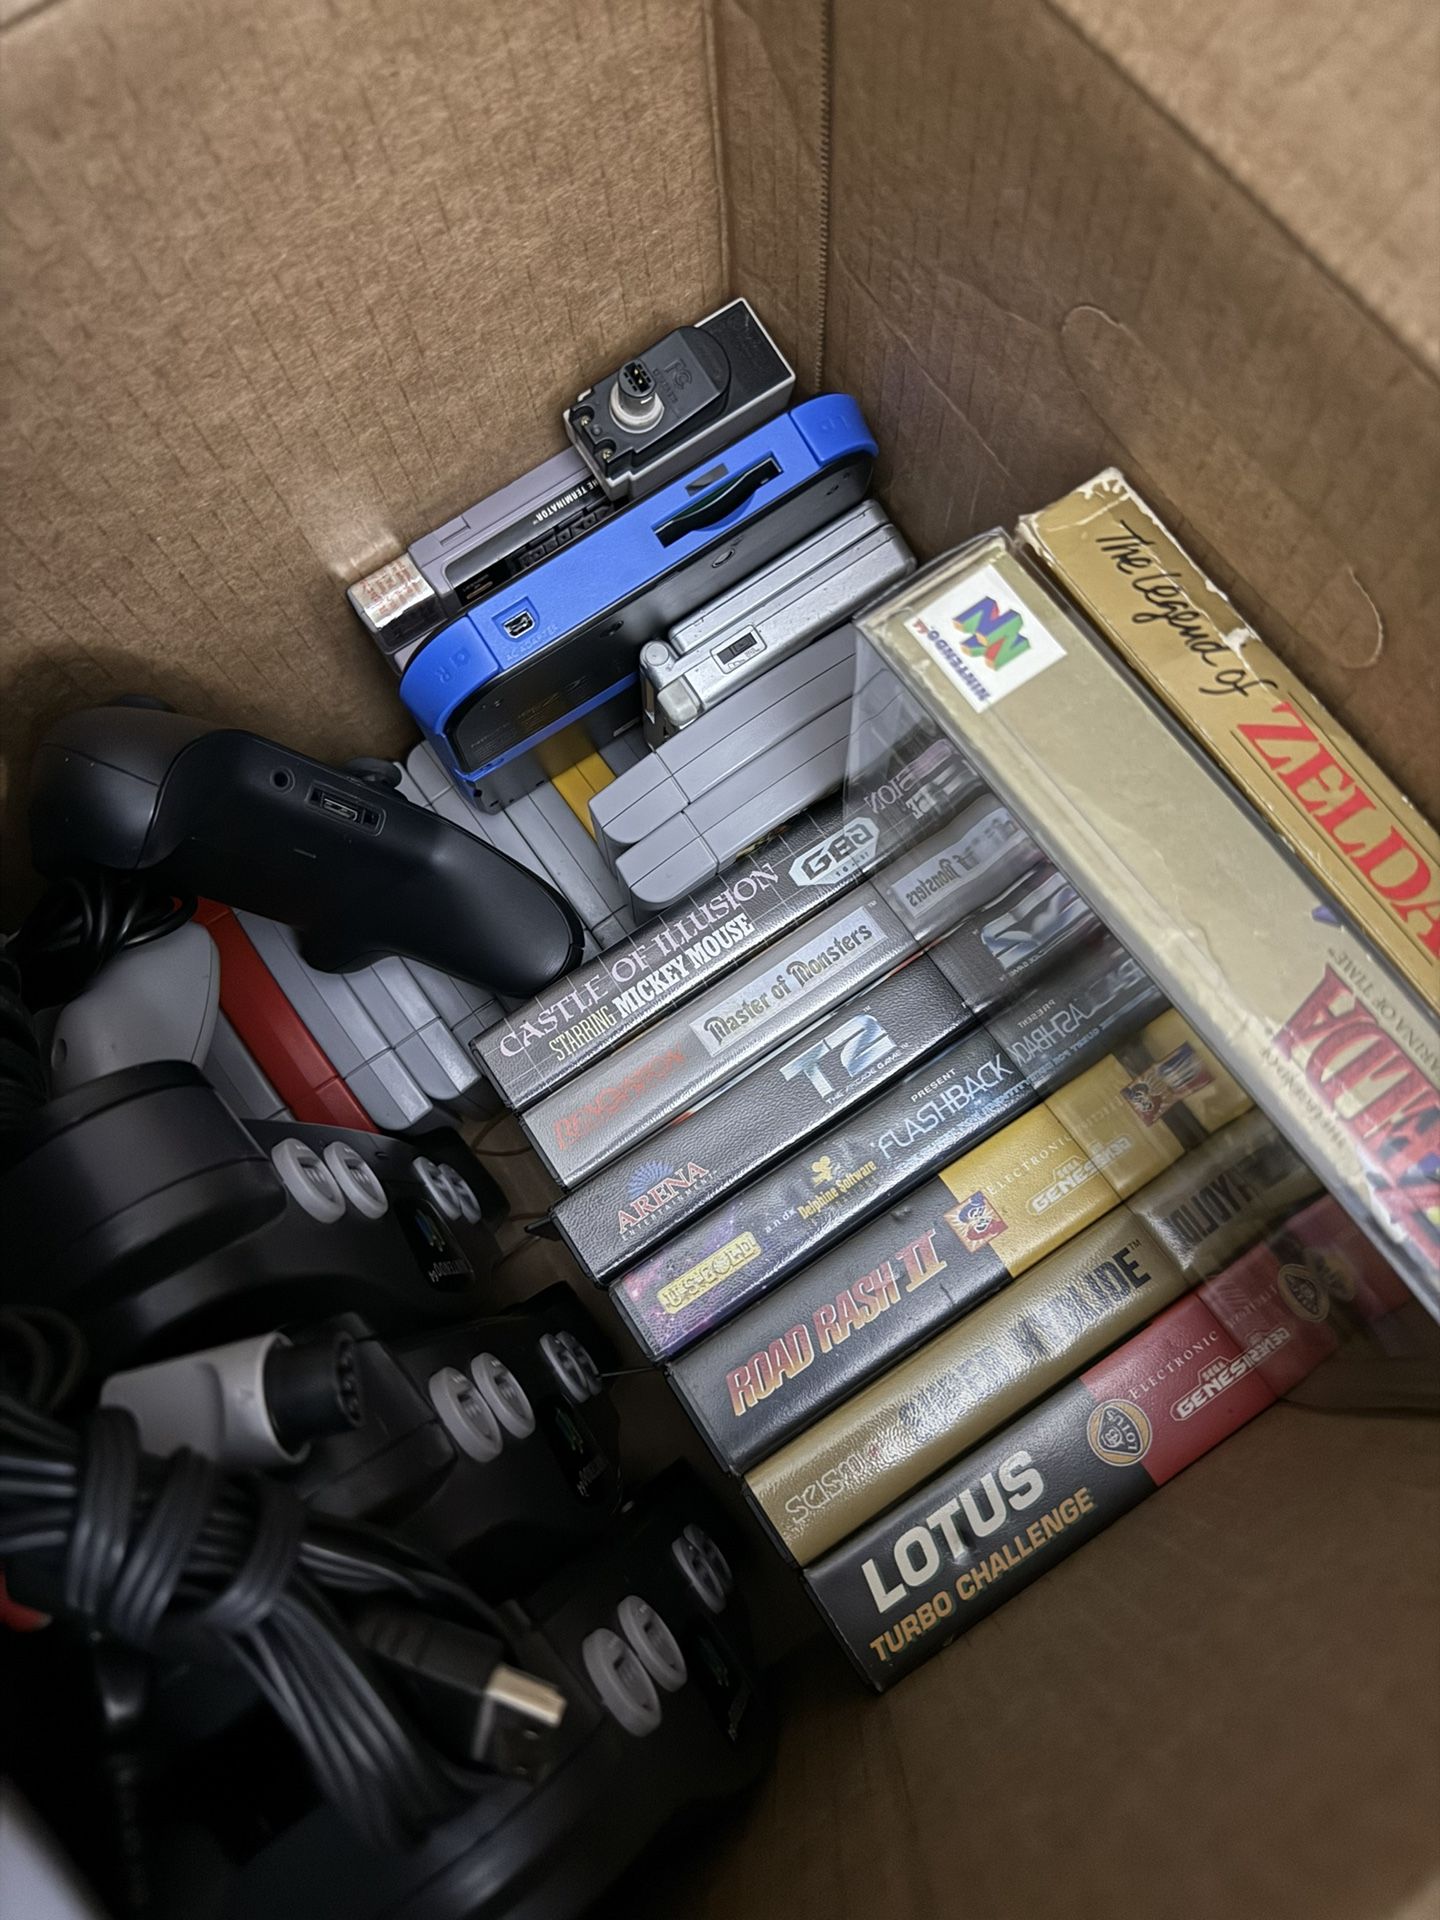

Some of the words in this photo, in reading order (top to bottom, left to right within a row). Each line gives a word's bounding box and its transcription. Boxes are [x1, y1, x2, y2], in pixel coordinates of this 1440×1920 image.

[534, 484, 588, 522] TERMINATOR
[1096, 520, 1151, 575] The
[1133, 574, 1219, 666] Legend
[1199, 663, 1276, 700] of
[495, 974, 609, 1060] CASTLE
[608, 943, 655, 985] OF
[651, 862, 780, 957] ILLUSION
[547, 1004, 618, 1061] STARRING
[611, 953, 692, 1019] MICKEY
[684, 912, 755, 970] MOUSE
[701, 989, 772, 1045] Master
[768, 974, 792, 1000] of
[785, 918, 874, 987] Monsters
[779, 1007, 897, 1098] T2
[875, 1053, 1013, 1159] FLASHBACK
[910, 1068, 956, 1102] PRESENT
[610, 1157, 709, 1235] ARENA
[797, 1185, 840, 1221] Delphine
[834, 1159, 878, 1194] Software
[722, 1321, 816, 1417] ROAD
[810, 1261, 904, 1353] RASH
[892, 1227, 947, 1292] II
[1129, 1329, 1219, 1399] ELECTRONIC
[859, 1448, 1051, 1613] LOTUS
[869, 1589, 955, 1661] TURBO
[952, 1486, 1096, 1601] CHALLENGE
